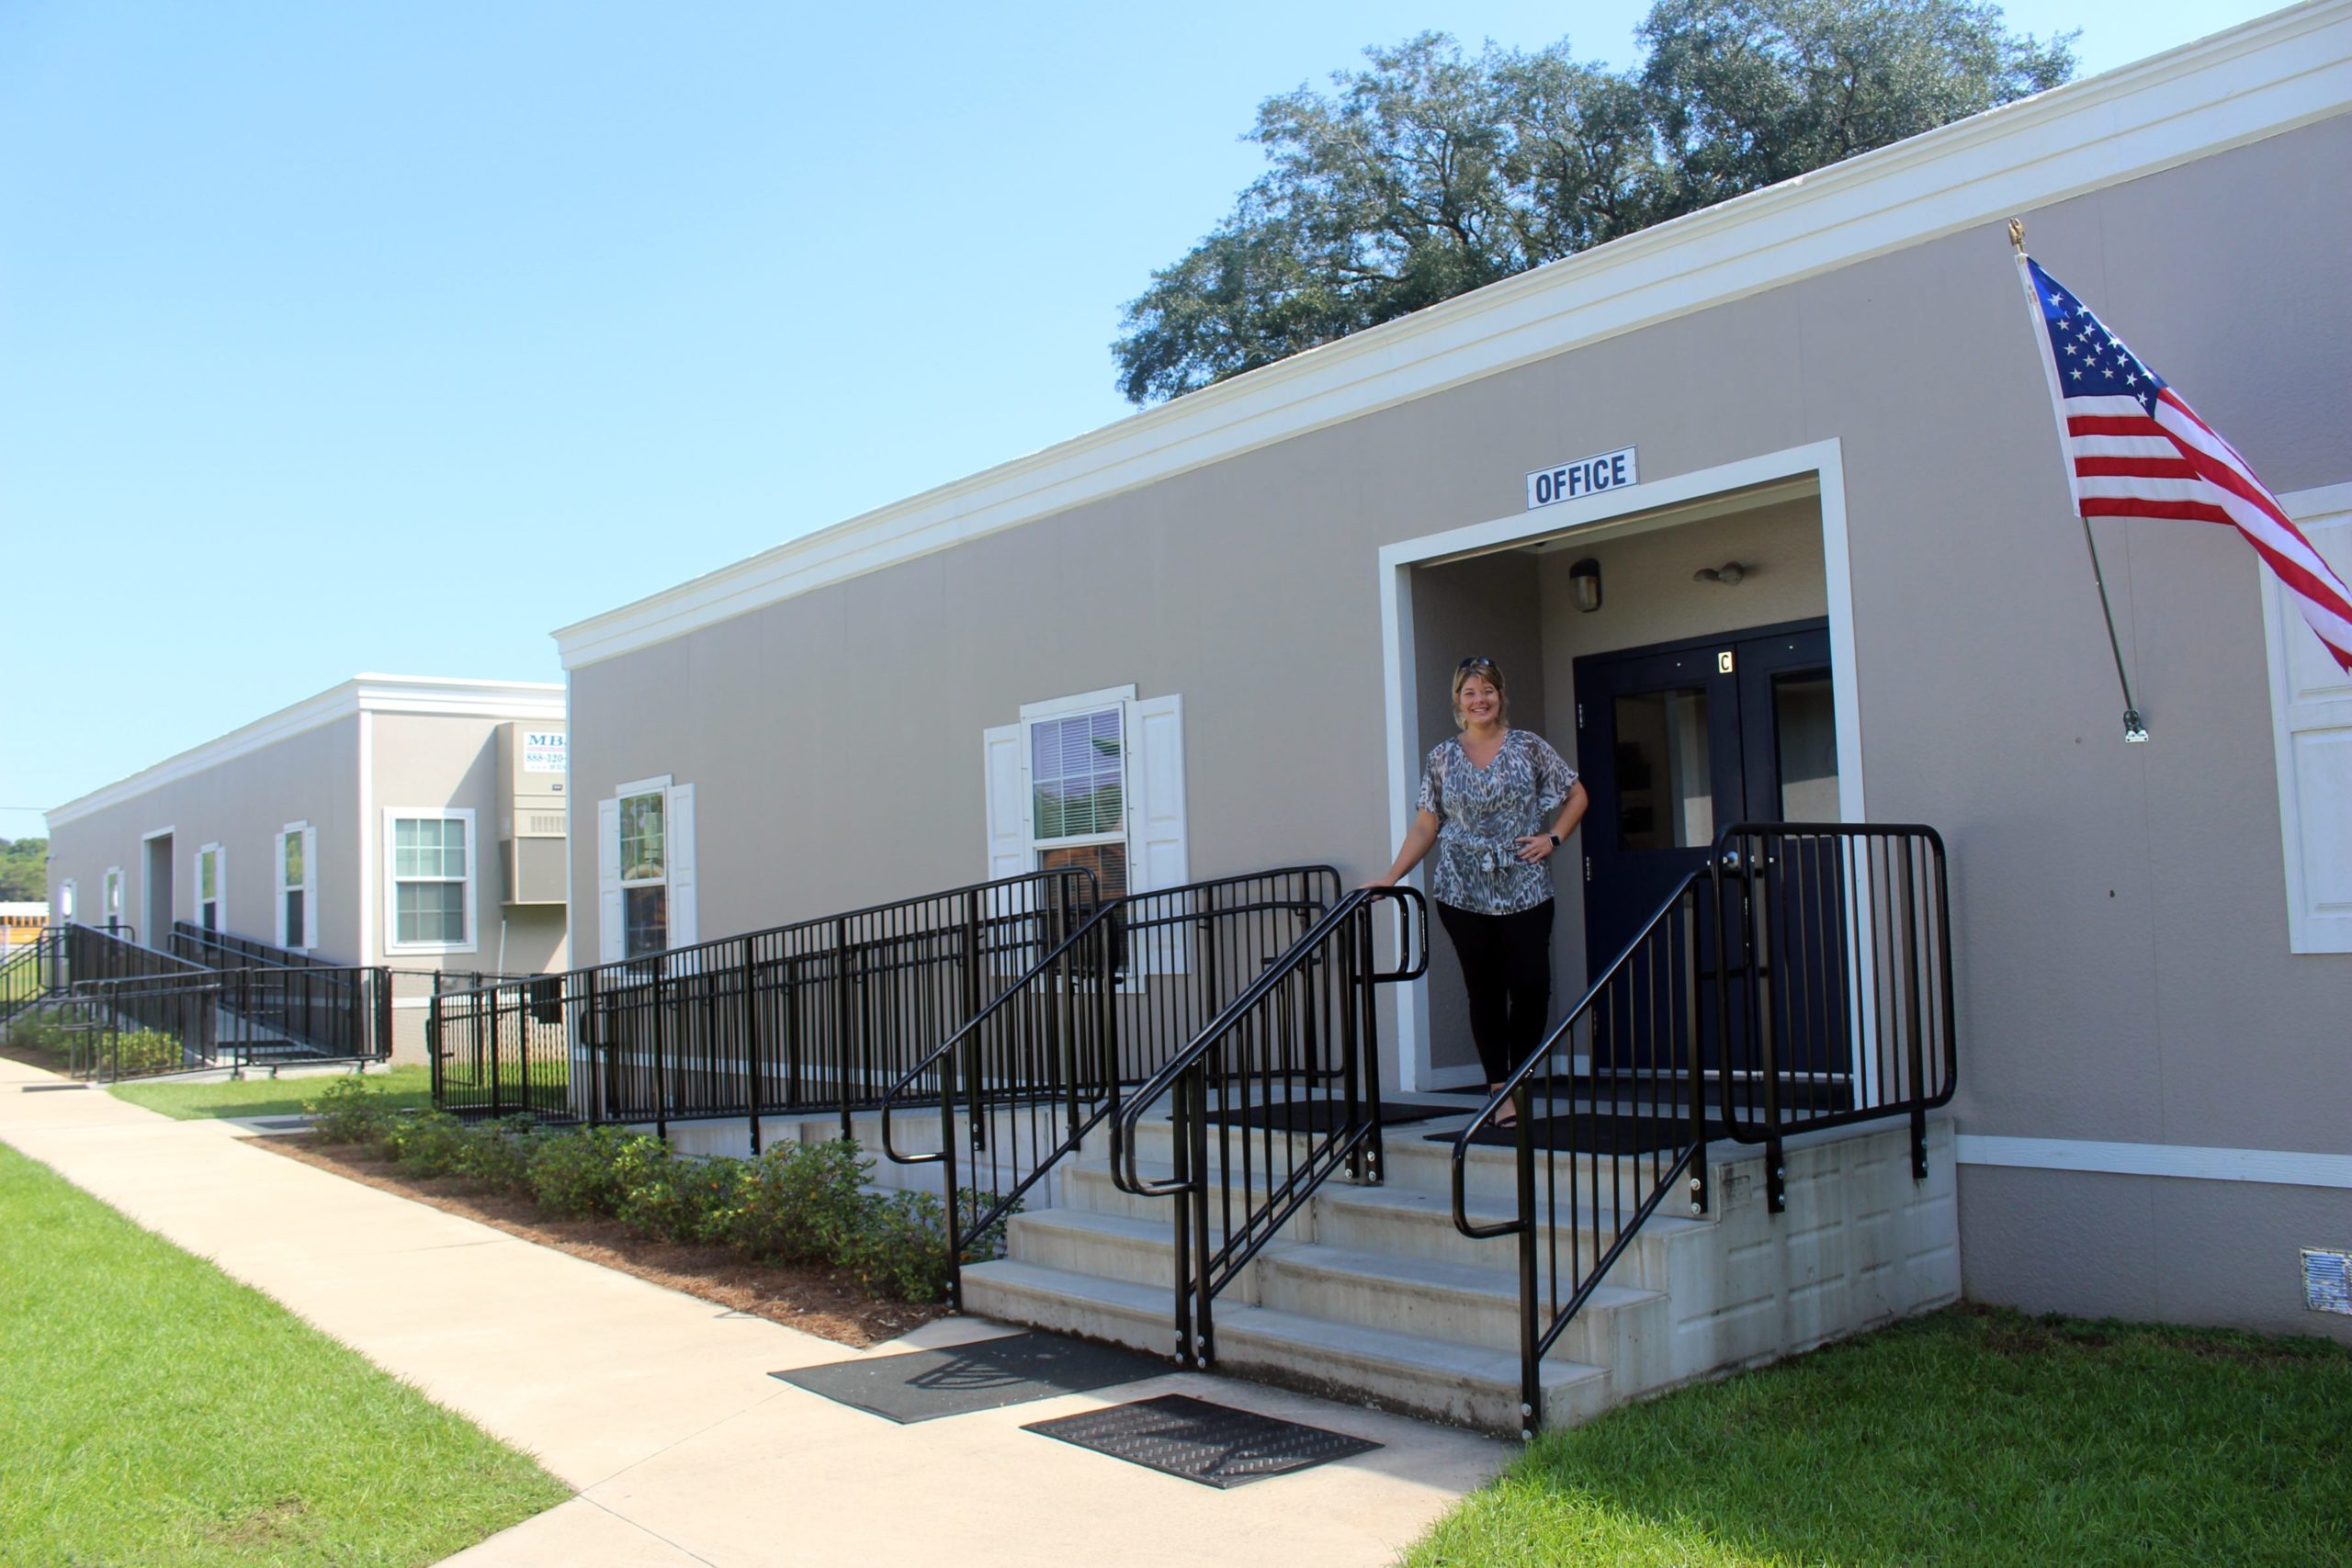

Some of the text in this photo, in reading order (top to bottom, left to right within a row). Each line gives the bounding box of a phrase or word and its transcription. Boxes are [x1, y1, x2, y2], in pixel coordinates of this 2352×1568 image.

[1536, 455, 1626, 504] OFFICE
[1721, 654, 1729, 671] C
[528, 734, 567, 746] MB
